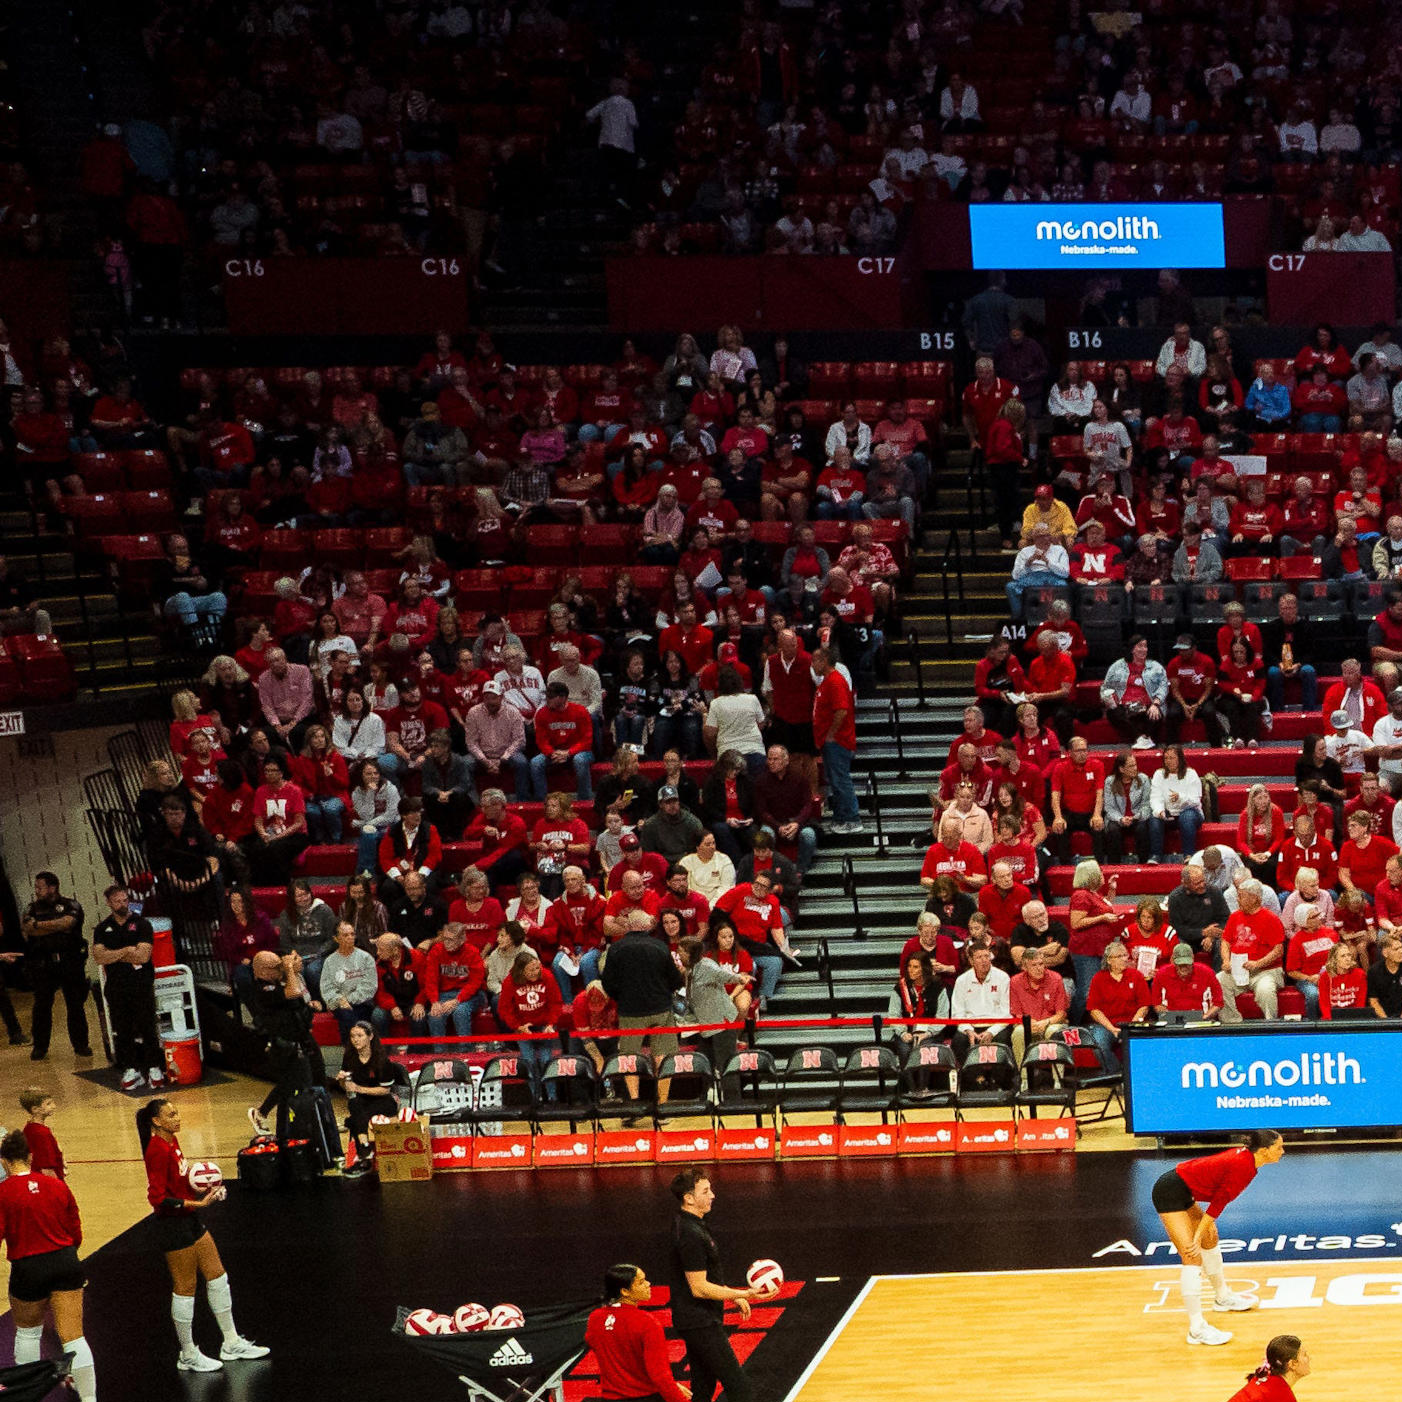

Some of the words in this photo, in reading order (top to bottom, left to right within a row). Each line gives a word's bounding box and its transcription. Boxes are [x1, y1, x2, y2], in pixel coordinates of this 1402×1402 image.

[226, 260, 264, 276] C16
[421, 259, 460, 275] C16
[857, 258, 895, 274] C17
[1269, 254, 1306, 271] C17
[920, 333, 955, 349] B15
[1069, 331, 1102, 348] B16
[1083, 553, 1107, 573] N
[1001, 625, 1027, 640] A14
[266, 799, 287, 819] N
[1063, 1028, 1081, 1046] N
[802, 1049, 822, 1069] N
[860, 1049, 880, 1067] N
[919, 1047, 939, 1064] N
[978, 1045, 998, 1064] N
[1038, 1043, 1058, 1060] N
[433, 1060, 453, 1080] N
[499, 1059, 517, 1076] N
[557, 1059, 576, 1076] N
[618, 1055, 637, 1073] N
[674, 1054, 694, 1072] N
[740, 1053, 758, 1071] N
[1217, 1095, 1331, 1108] Nebraska-made.
[722, 1142, 754, 1151] Ameritas
[785, 1139, 818, 1147] Ameritas
[843, 1139, 877, 1147] Ameritas
[904, 1135, 937, 1144] Ameritas
[962, 1135, 994, 1144] Aeritas
[539, 1148, 573, 1157] Ameritas
[601, 1145, 636, 1154] Ameritas
[660, 1144, 694, 1153] Ameritas
[490, 1353, 533, 1366] adidas
